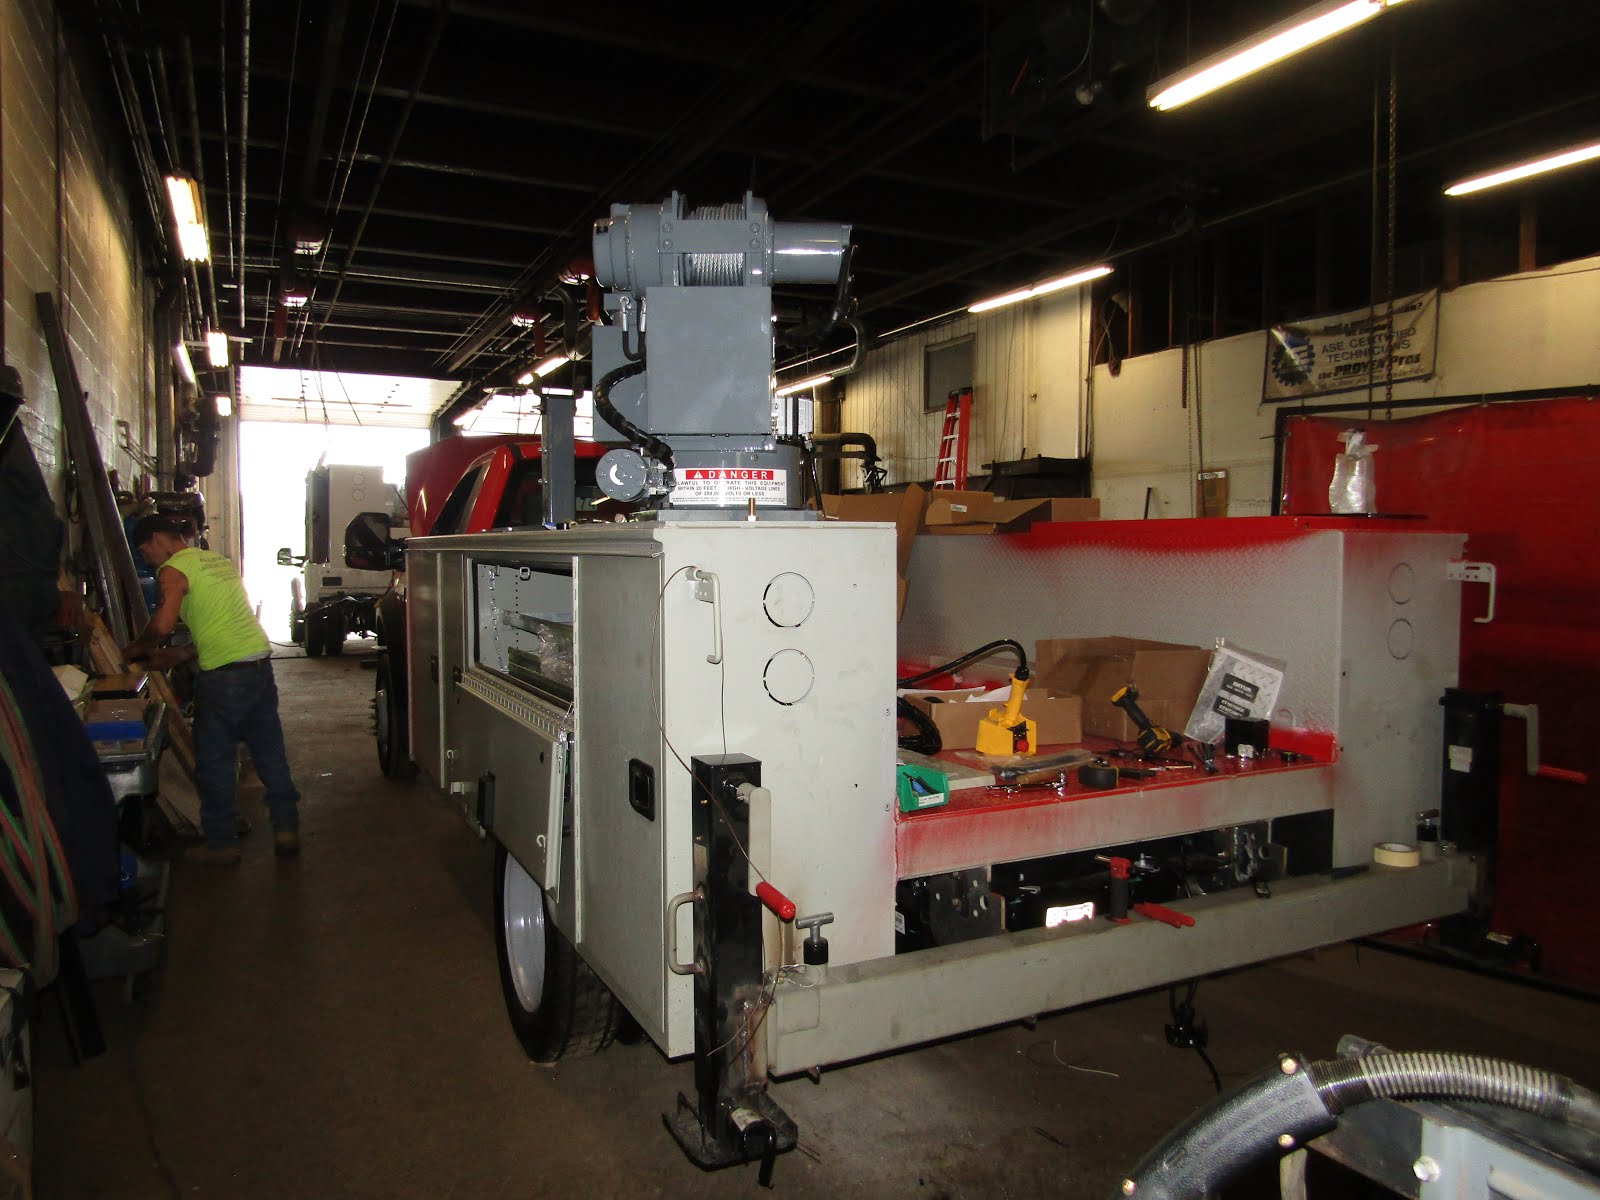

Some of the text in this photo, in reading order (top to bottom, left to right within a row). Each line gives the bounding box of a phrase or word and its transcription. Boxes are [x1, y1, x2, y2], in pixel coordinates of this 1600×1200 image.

[1322, 341, 1344, 354] ASE
[1327, 340, 1410, 363] TECHNCINS
[708, 470, 768, 479] DANGER
